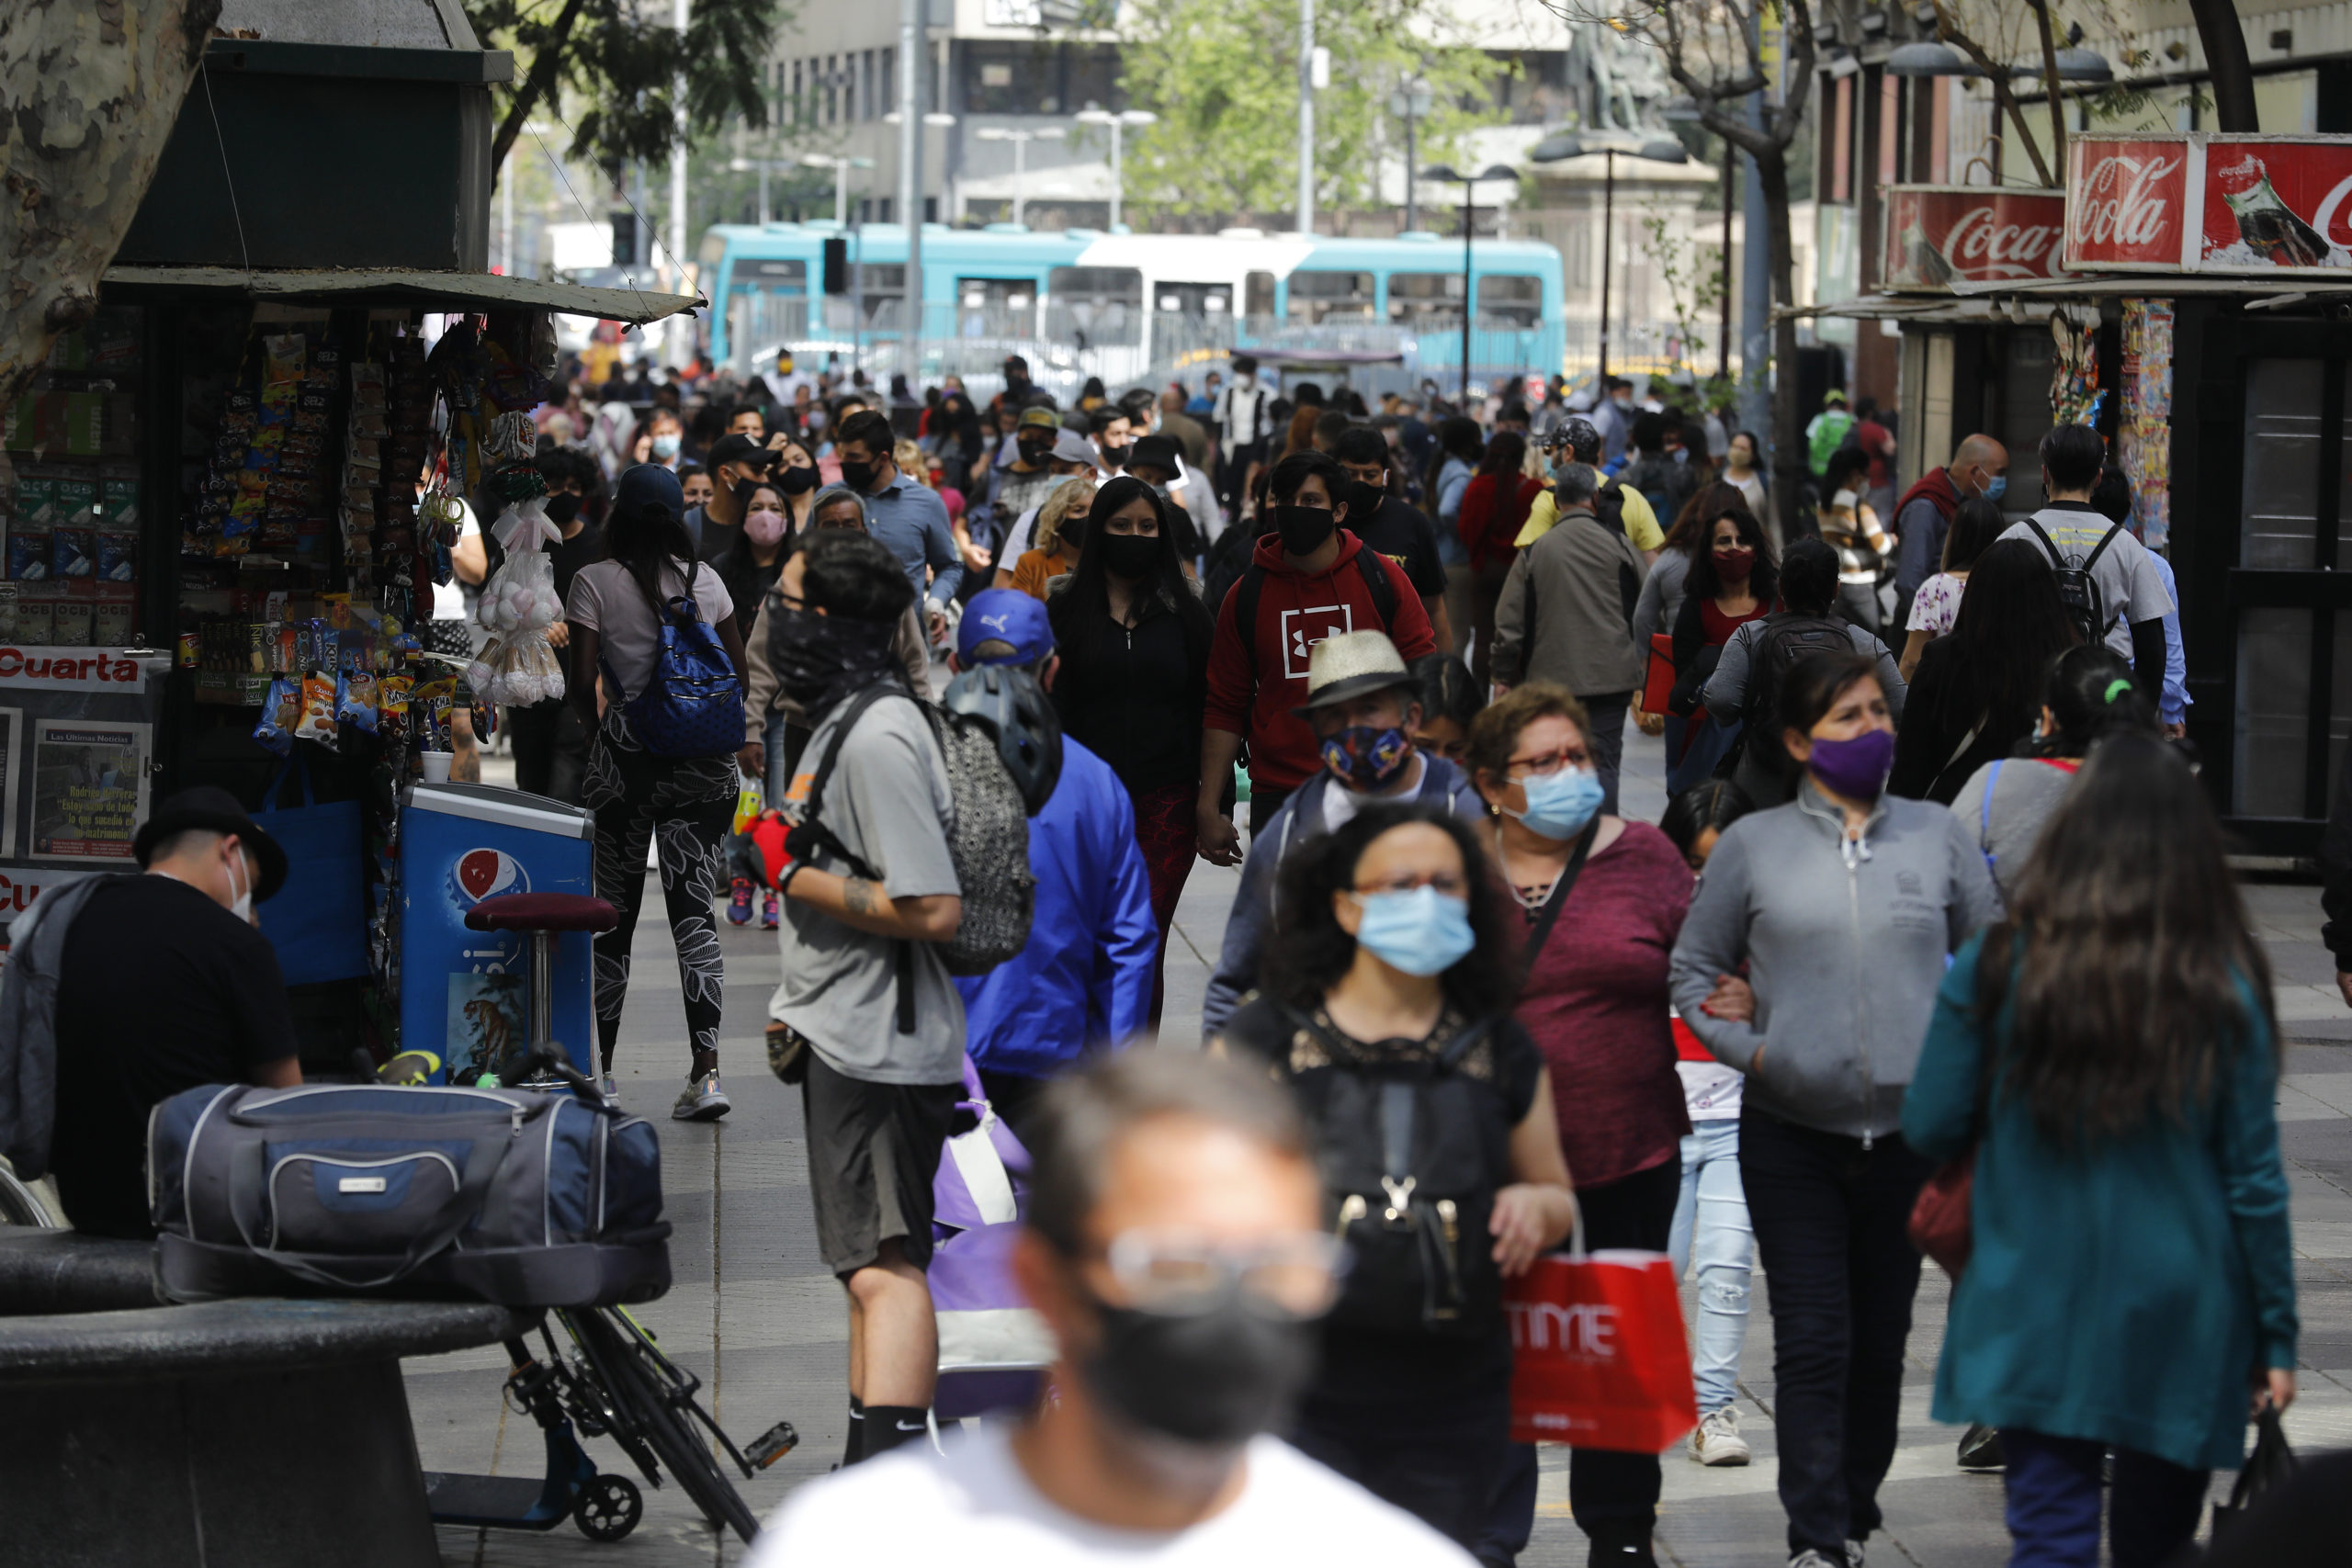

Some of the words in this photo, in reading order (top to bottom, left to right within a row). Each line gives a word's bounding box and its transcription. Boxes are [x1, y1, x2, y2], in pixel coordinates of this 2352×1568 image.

[2076, 155, 2182, 245] Cola
[19, 605, 50, 615] OCB
[58, 605, 89, 616] OCB
[99, 606, 129, 616] OCB
[0, 648, 138, 682] Cuarta
[97, 735, 129, 743] Noticias
